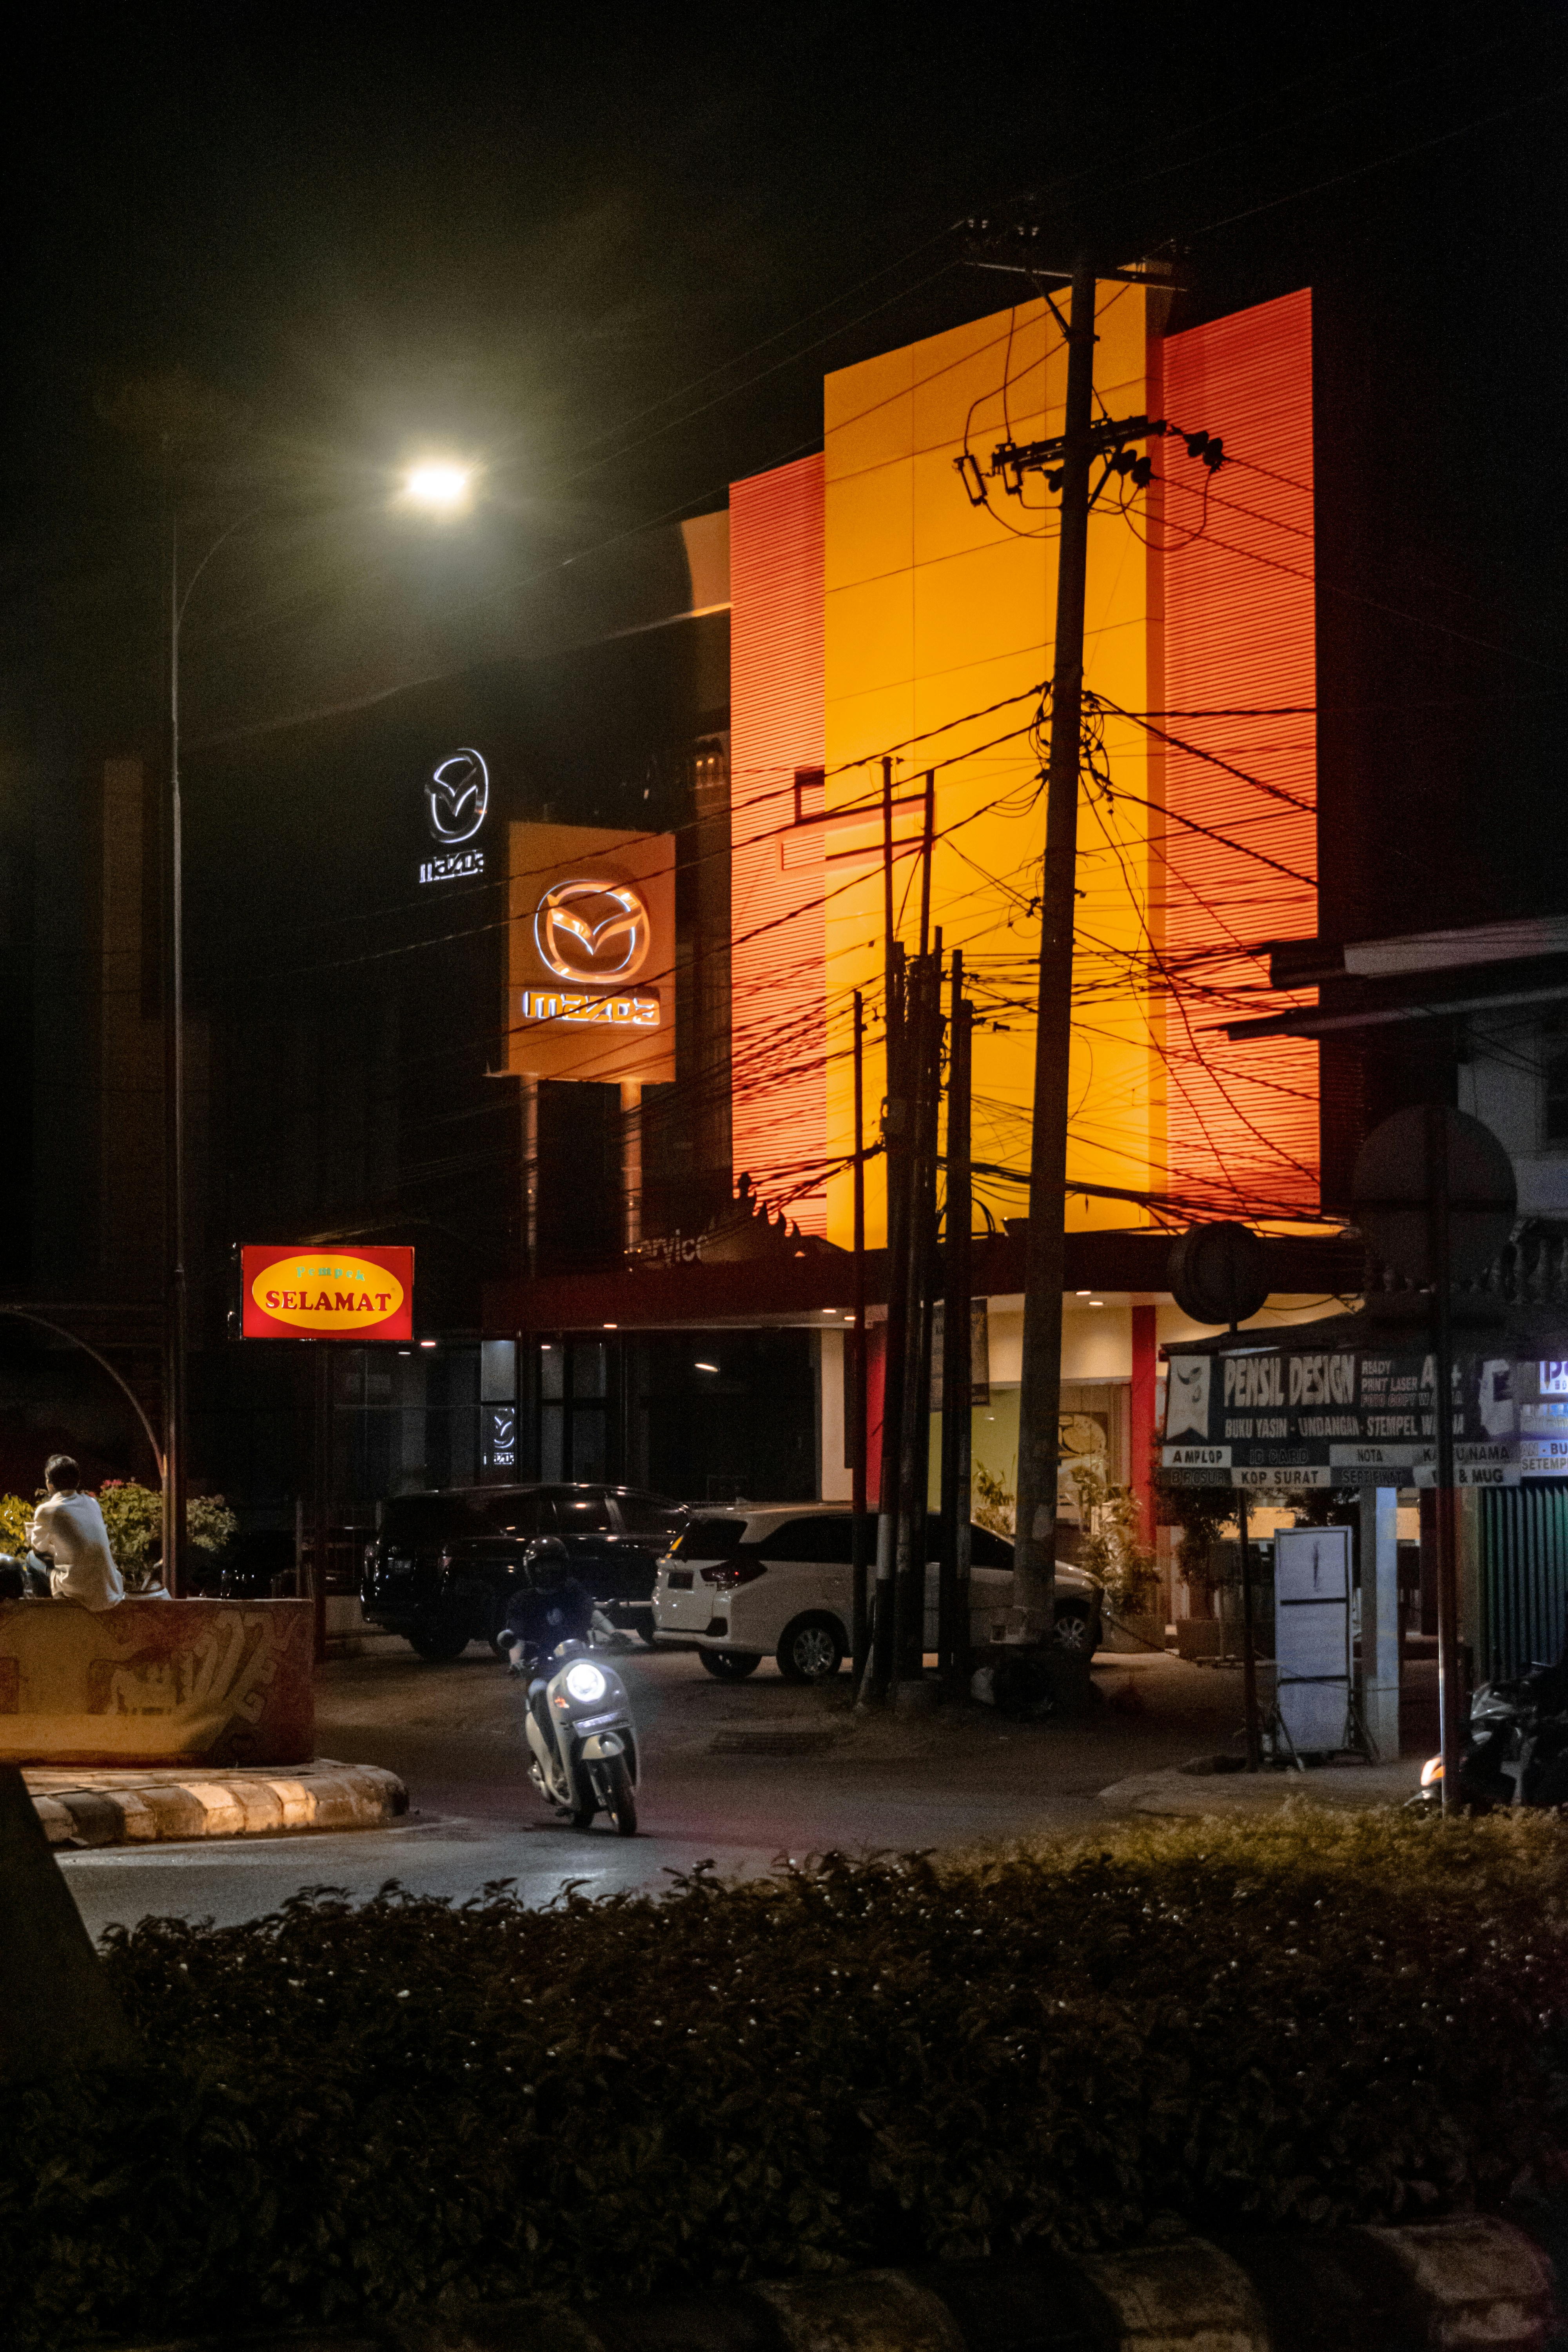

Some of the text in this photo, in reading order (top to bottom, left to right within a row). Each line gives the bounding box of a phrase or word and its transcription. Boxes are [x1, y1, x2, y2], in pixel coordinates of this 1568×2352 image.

[522, 991, 660, 1025] mazda
[296, 1267, 365, 1281] Pempek
[266, 1290, 391, 1311] SELAMAT
[1362, 1360, 1392, 1375] READY
[1224, 1355, 1354, 1407] PENSIL DESIGN
[1362, 1376, 1418, 1392] PRINT LASER
[1388, 1393, 1416, 1407] COPY
[1225, 1419, 1253, 1438] BUKU
[1256, 1418, 1287, 1438] YASIN
[1298, 1416, 1359, 1437] UNDANGAN
[1367, 1415, 1418, 1436] STEMPEL
[1172, 1450, 1222, 1463] AMPLOP
[1249, 1448, 1309, 1465] ID CARD
[1357, 1449, 1383, 1462] NOTA
[1469, 1445, 1510, 1460] NAMA
[1522, 1457, 1568, 1470] SETEMP
[1171, 1470, 1226, 1486] BROSUR
[1241, 1470, 1319, 1485] KOP SURAT
[1342, 1470, 1402, 1485] SERTIFIKAT
[1472, 1468, 1504, 1483] MUG
